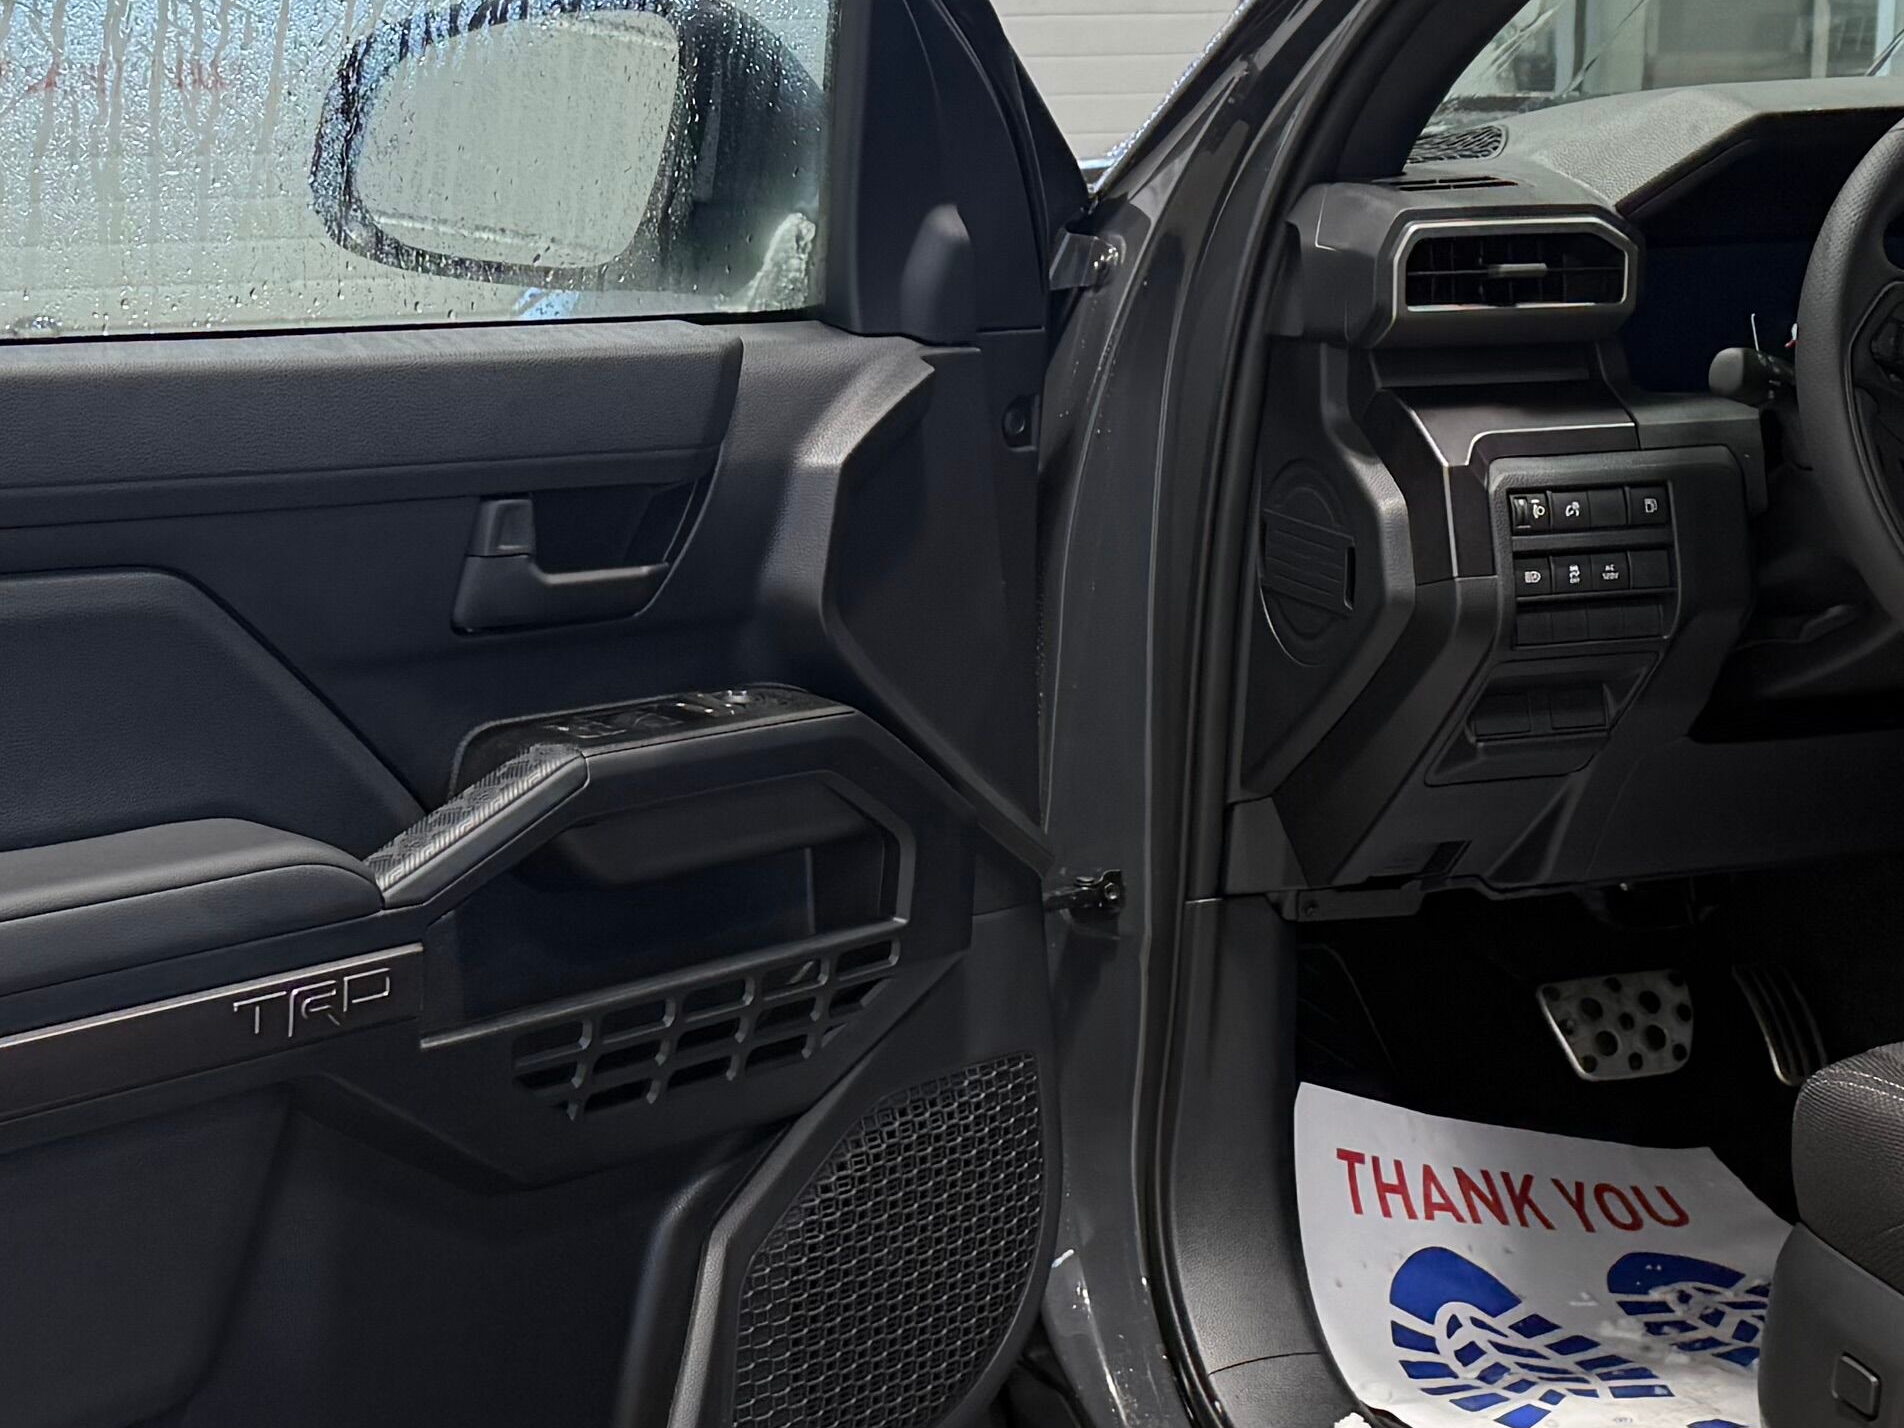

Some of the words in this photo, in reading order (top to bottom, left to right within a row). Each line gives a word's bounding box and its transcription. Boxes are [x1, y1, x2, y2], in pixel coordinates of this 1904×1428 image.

[233, 968, 391, 1038] TRD
[1336, 1147, 1556, 1230] THANK
[1550, 1178, 1690, 1233] YOU
